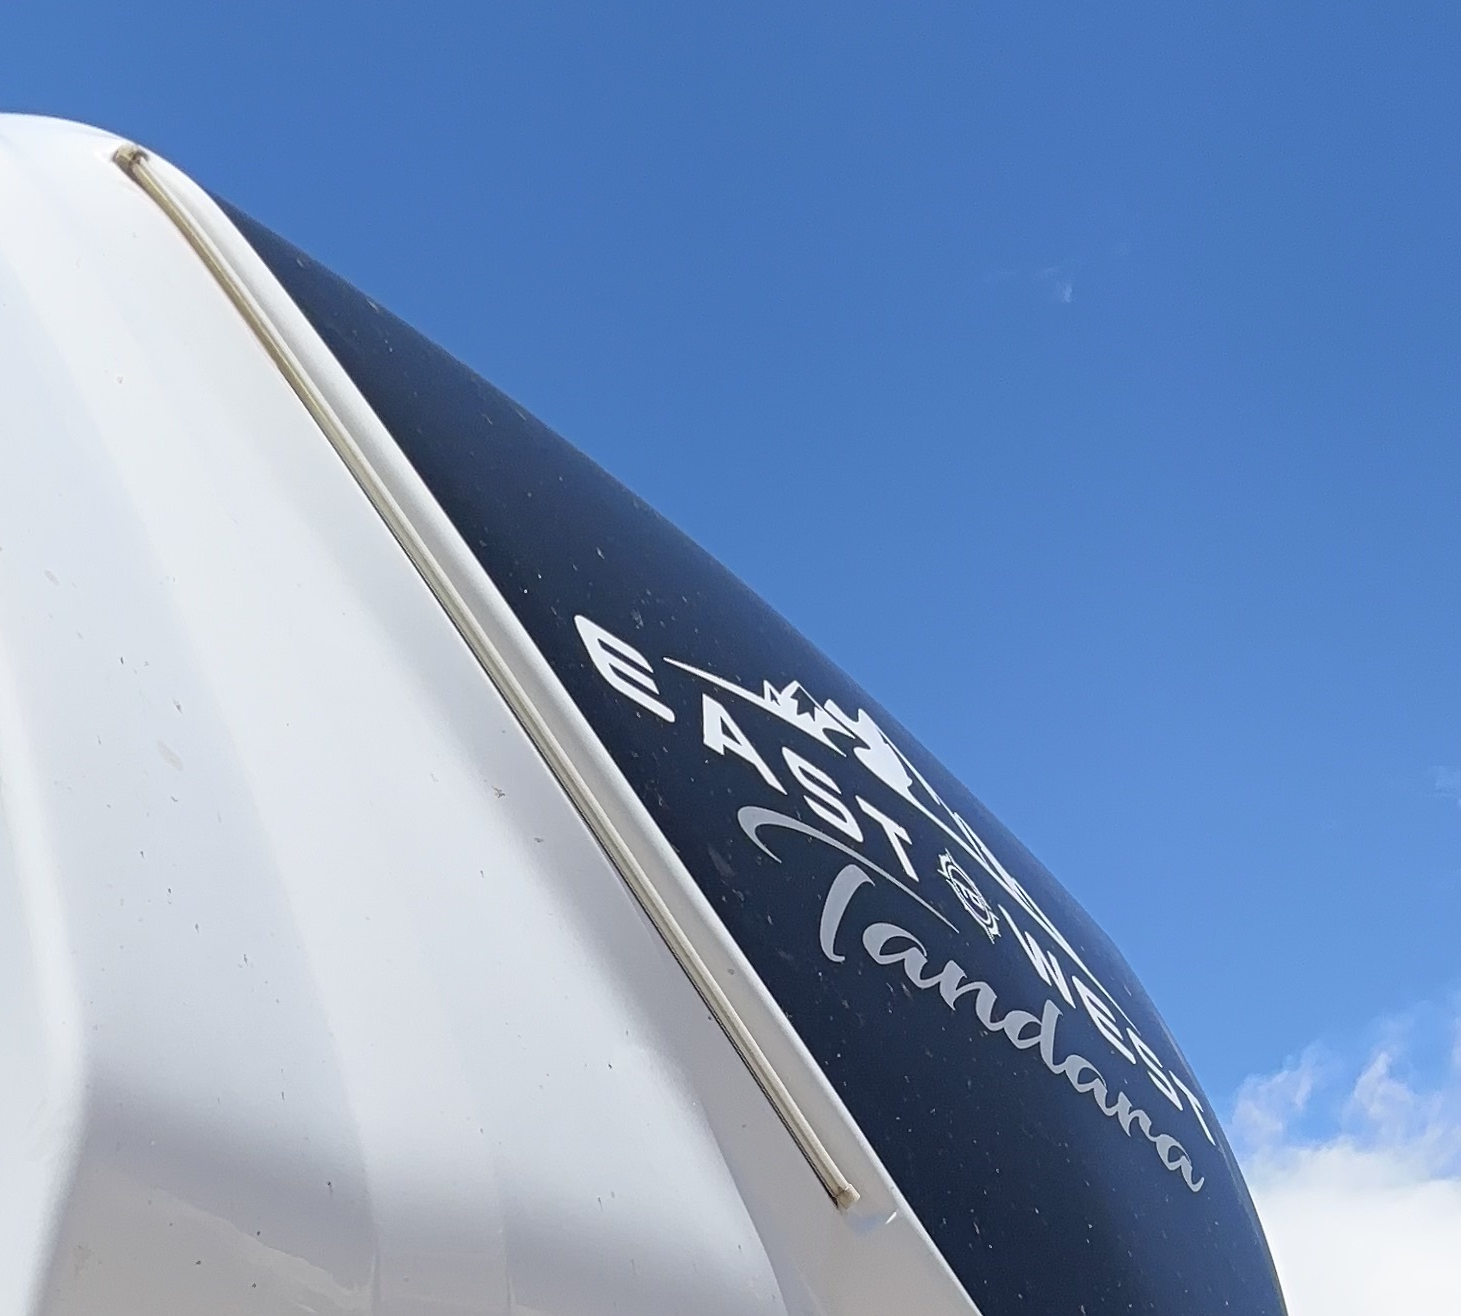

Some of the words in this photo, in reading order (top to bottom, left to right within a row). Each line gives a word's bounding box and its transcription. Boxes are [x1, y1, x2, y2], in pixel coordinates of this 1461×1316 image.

[574, 614, 919, 882] EAST
[999, 903, 1216, 1145] WEST
[736, 805, 1206, 1193] Tandara
